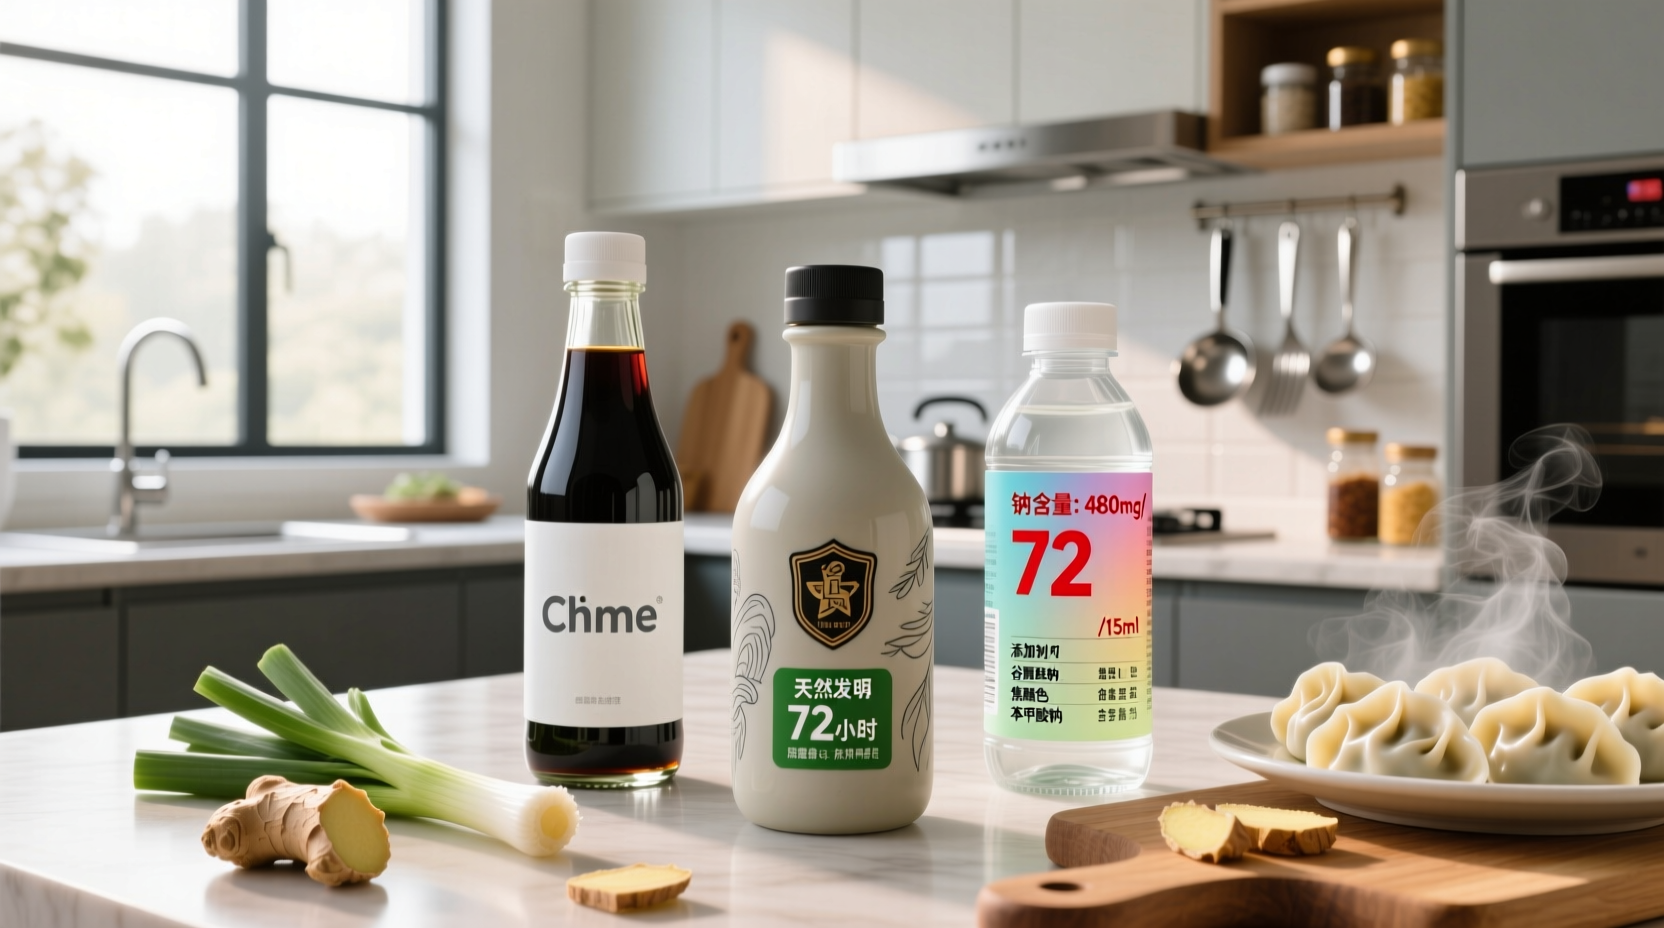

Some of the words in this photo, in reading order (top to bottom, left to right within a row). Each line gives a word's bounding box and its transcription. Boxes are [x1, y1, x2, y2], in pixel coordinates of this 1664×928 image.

[1012, 529, 1092, 597] 72
[1097, 616, 1139, 637] /15ml
[794, 677, 872, 699] 天然发明
